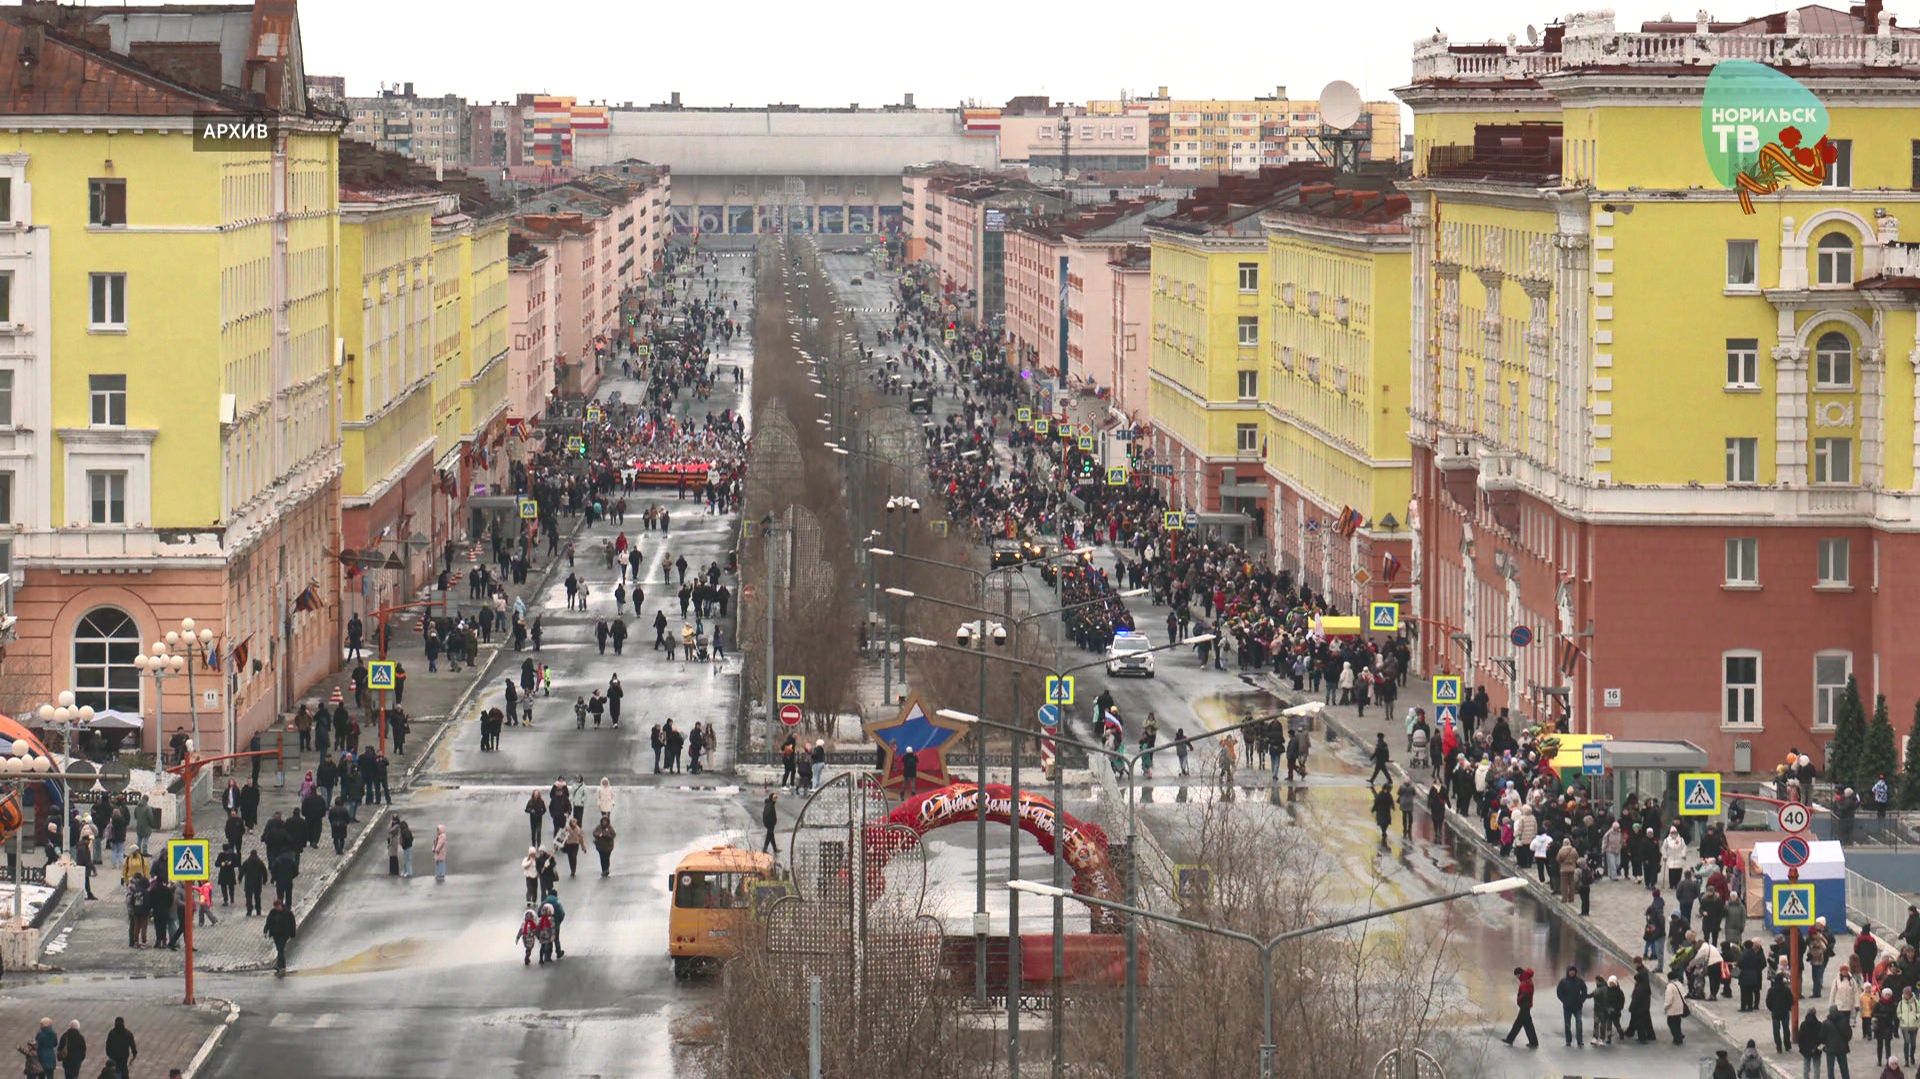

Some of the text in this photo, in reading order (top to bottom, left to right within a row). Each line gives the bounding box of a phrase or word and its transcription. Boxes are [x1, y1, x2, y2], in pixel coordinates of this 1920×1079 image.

[1607, 690, 1618, 700] 16
[921, 799, 936, 820] С
[1784, 811, 1804, 825] 40
